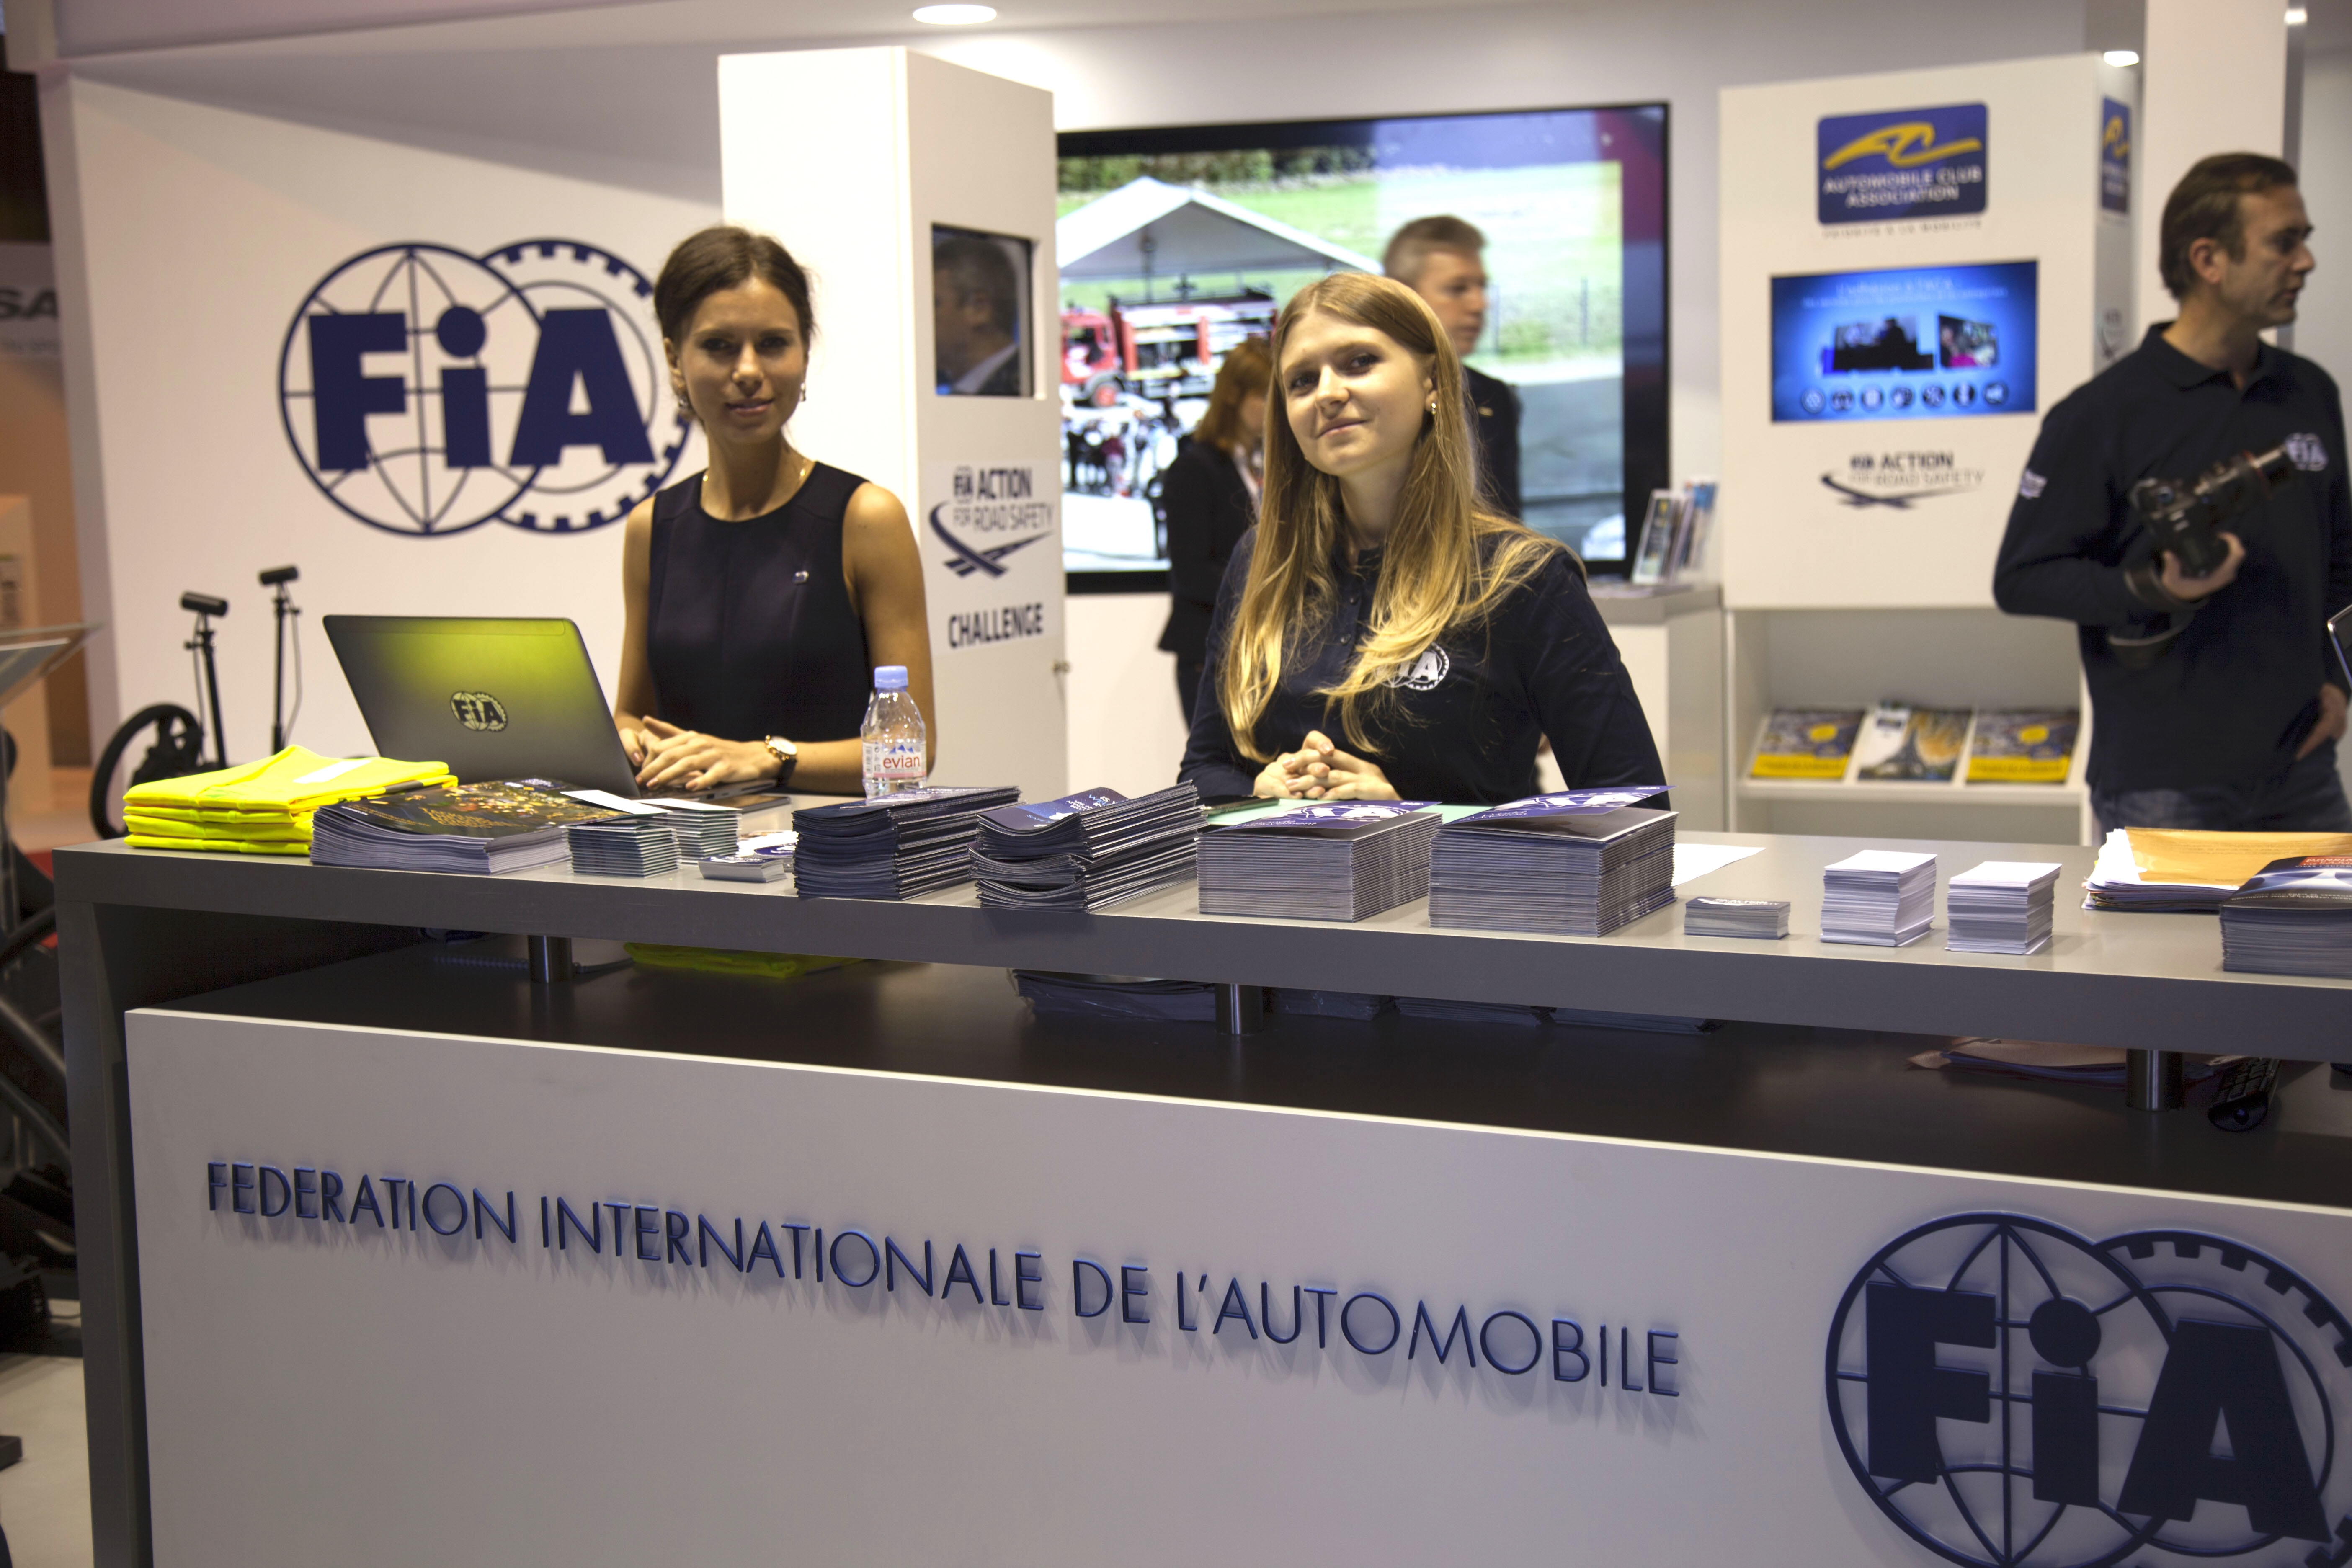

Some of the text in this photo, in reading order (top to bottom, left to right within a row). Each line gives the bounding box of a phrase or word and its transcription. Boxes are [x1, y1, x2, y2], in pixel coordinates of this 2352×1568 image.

[1823, 165, 1982, 194] AUTOMOBILE CLUB
[1845, 185, 1959, 207] ASSOCIATION
[1881, 452, 1954, 470] ACTION
[977, 467, 1032, 500] ACTION
[974, 504, 1005, 532] ROAD
[1010, 502, 1055, 530] SAFETY
[949, 602, 1042, 648] CHALLENGE
[883, 755, 920, 769] evian
[207, 1161, 1680, 1397] FEDERATION INTERNATIONALE DE L'AUTOMOBILE
